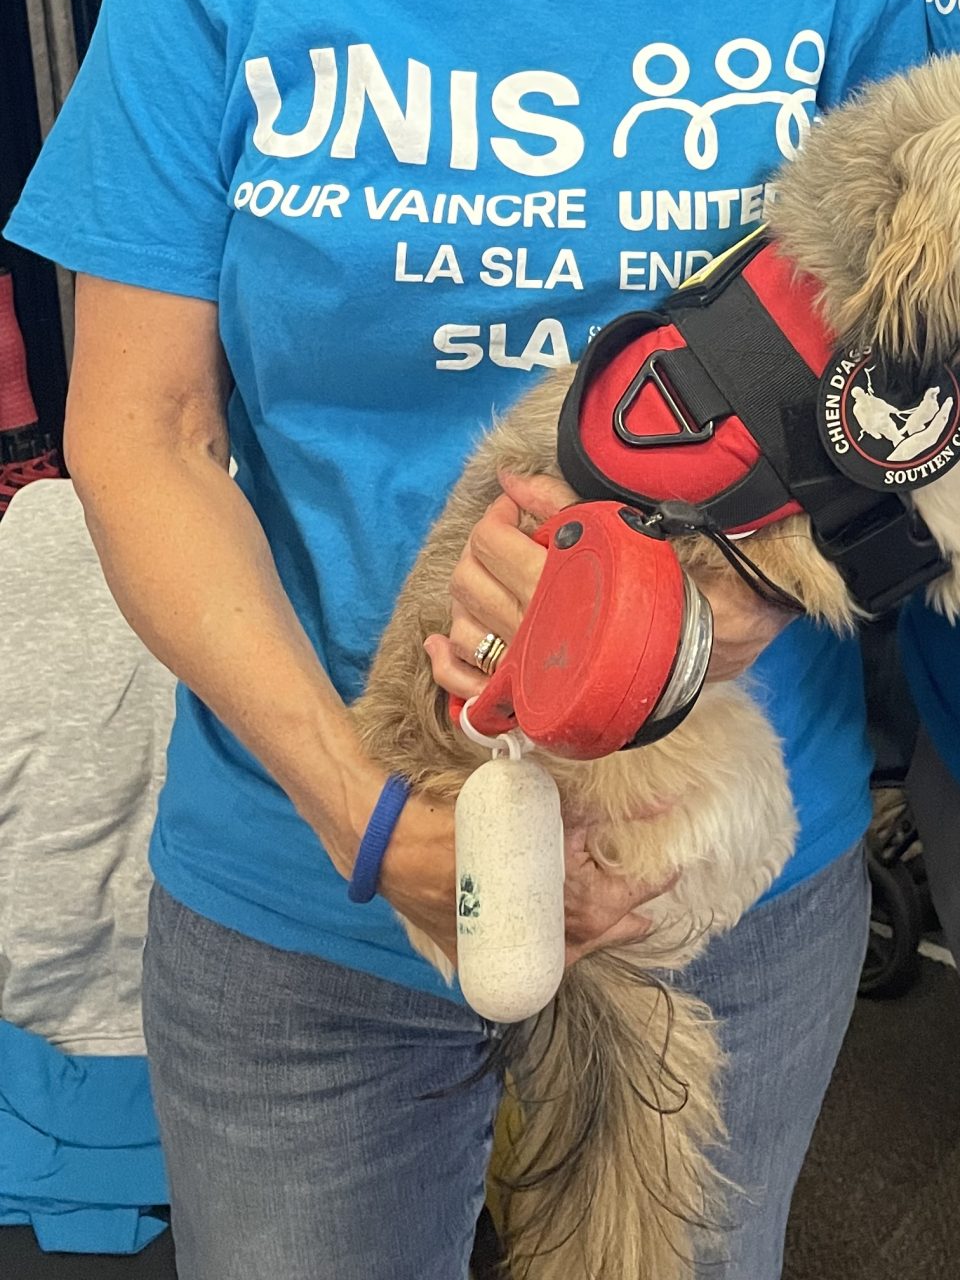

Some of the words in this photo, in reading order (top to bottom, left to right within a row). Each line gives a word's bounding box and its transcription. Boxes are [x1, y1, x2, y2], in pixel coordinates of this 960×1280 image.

[244, 43, 585, 176] UNIS
[363, 187, 587, 230] VAINCRE
[394, 242, 464, 284] LA
[479, 246, 584, 291] SLA
[433, 318, 571, 372] SLA
[825, 394, 850, 454] CHIEN
[883, 445, 955, 485] SOUTIEN
